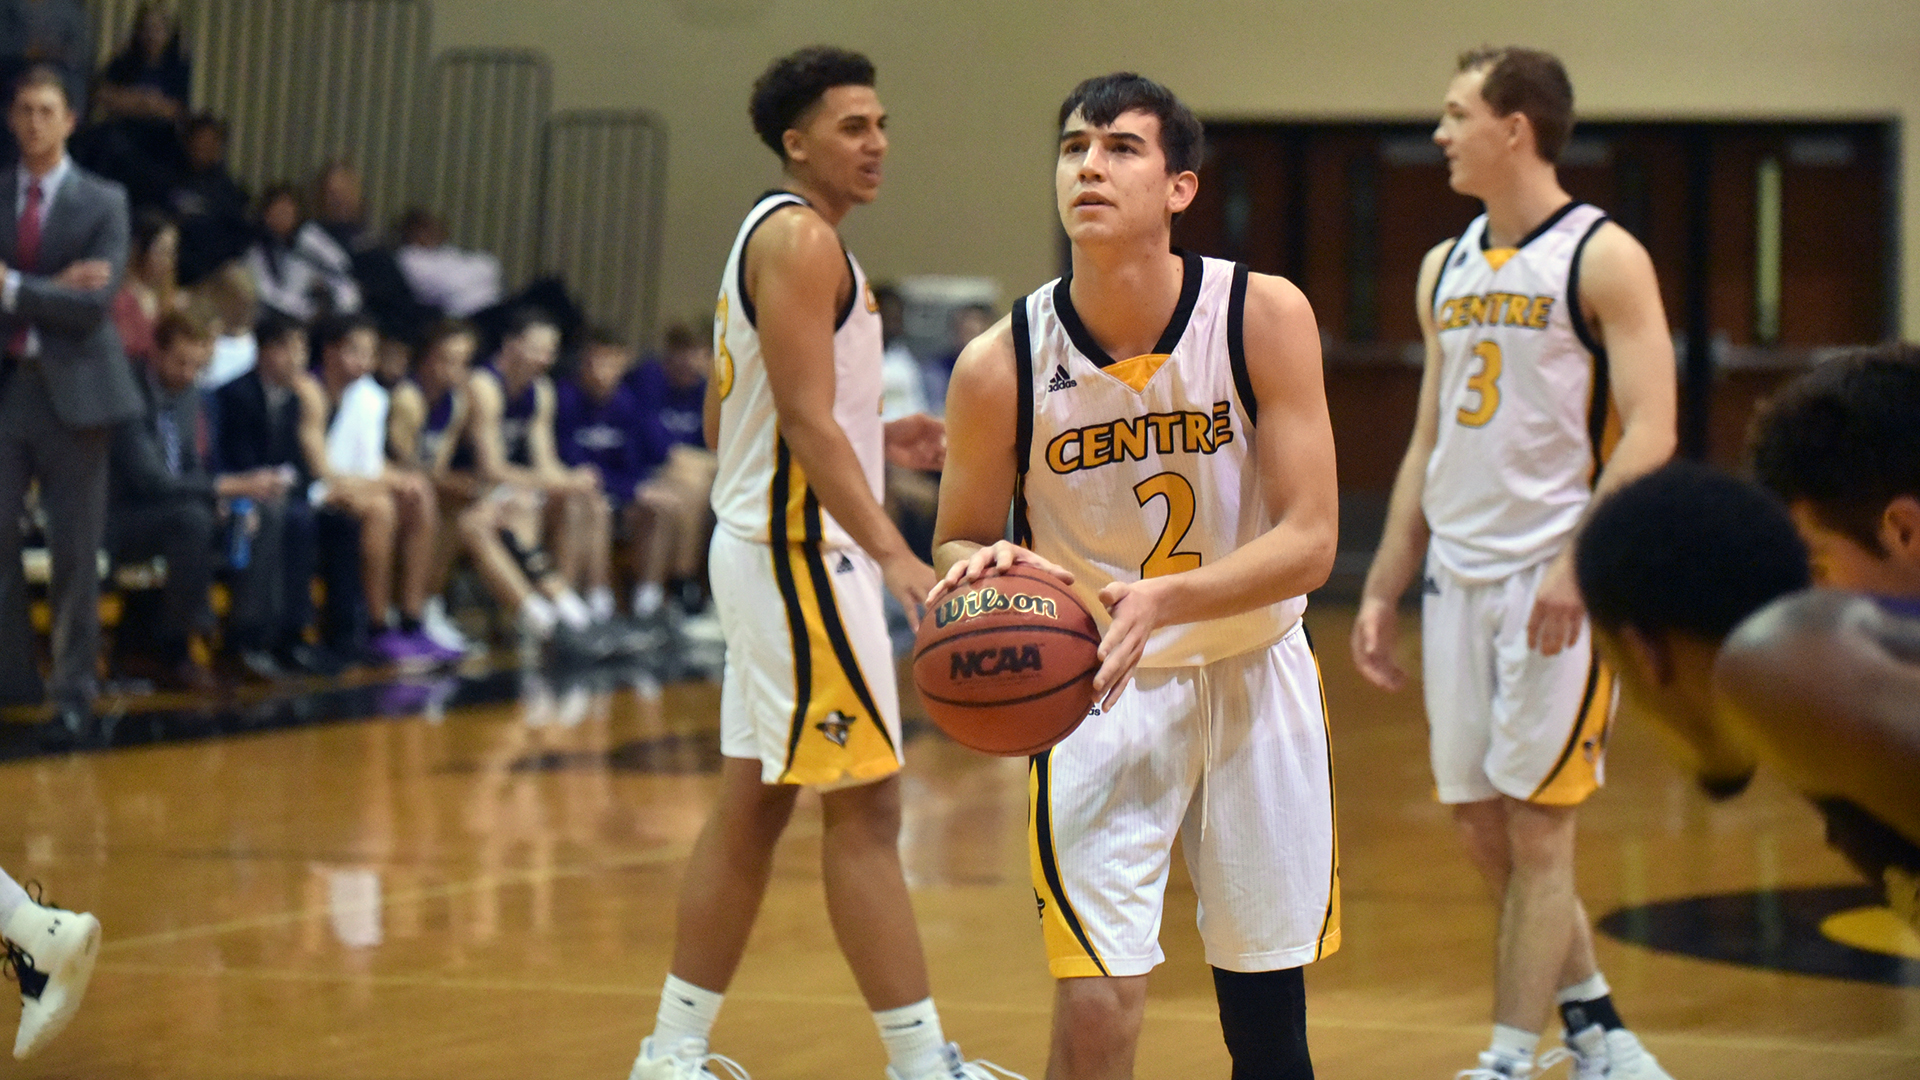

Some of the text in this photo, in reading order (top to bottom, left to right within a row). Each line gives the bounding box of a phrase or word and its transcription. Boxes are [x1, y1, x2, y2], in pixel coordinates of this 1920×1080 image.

[1439, 290, 1555, 330] CENTRE
[1048, 379, 1077, 392] addas
[1456, 339, 1503, 428] 3
[1046, 400, 1233, 474] CENTRE
[1133, 471, 1202, 580] 2
[935, 587, 1058, 629] Wilson
[950, 644, 1042, 680] NCAA
